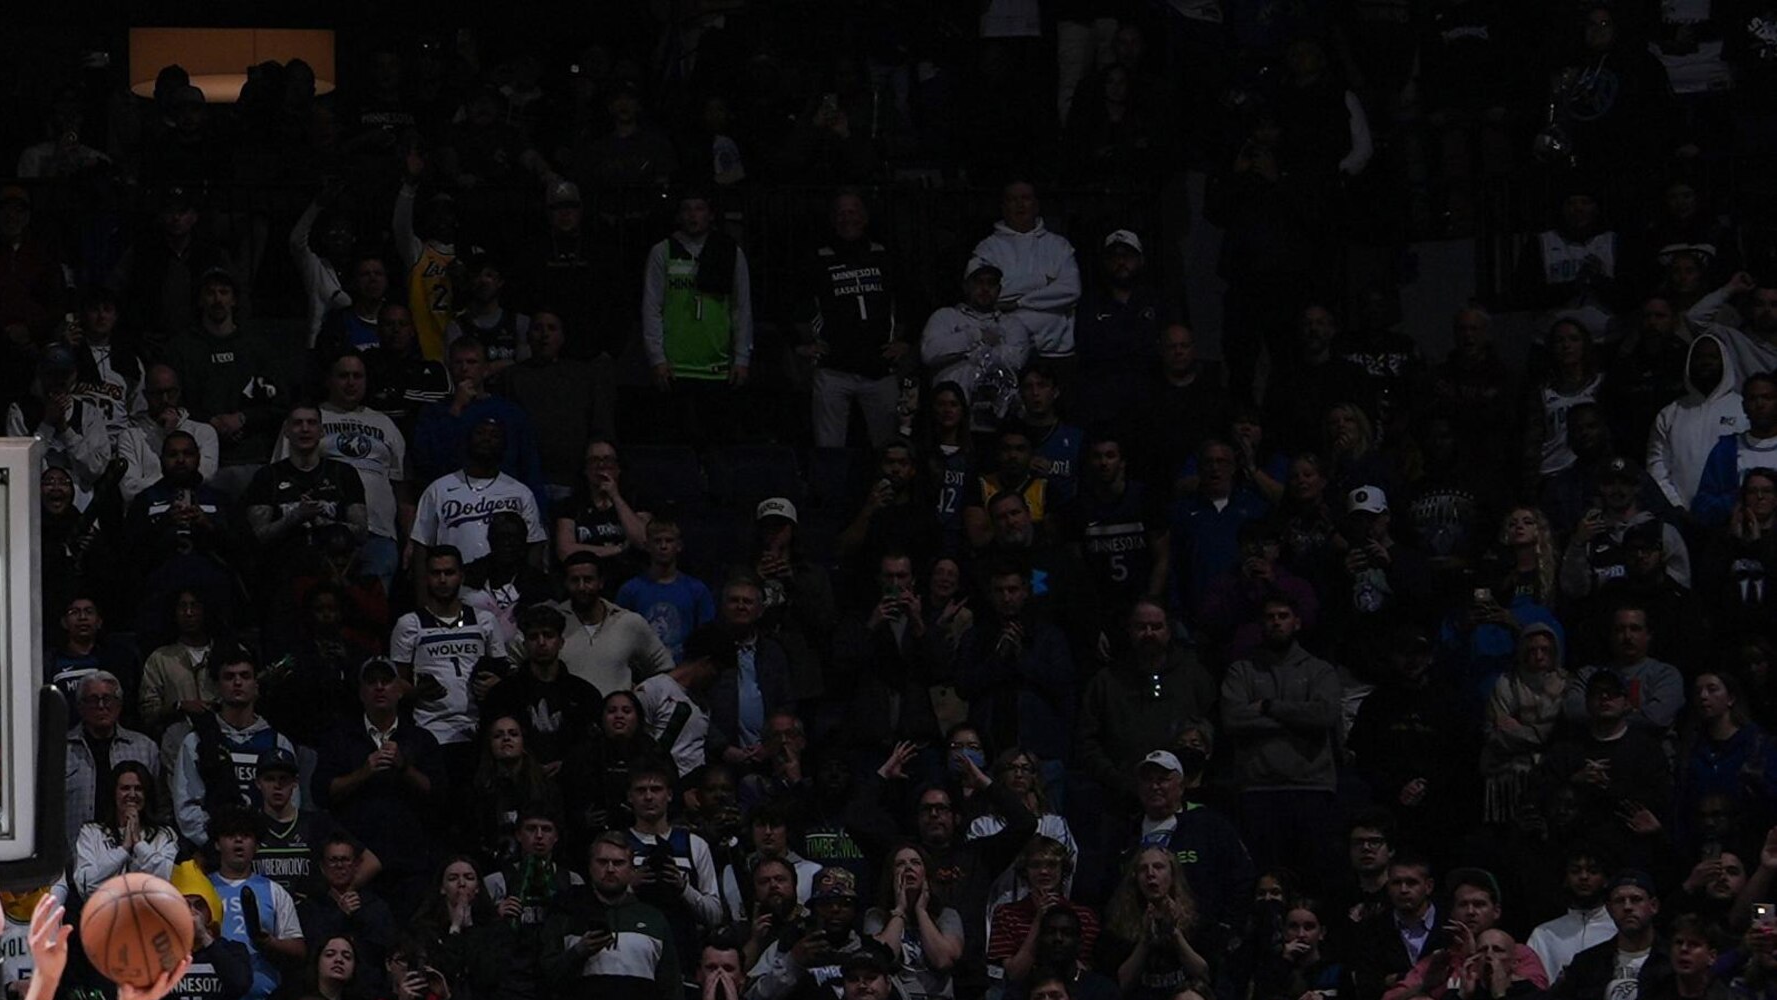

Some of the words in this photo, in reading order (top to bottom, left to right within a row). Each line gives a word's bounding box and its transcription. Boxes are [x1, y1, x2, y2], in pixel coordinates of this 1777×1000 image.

[831, 266, 882, 285] MINNESOTA
[833, 282, 885, 298] BASKETBALL
[856, 295, 868, 321] 1
[443, 497, 520, 527] Dodgers
[1110, 555, 1129, 582] 5
[427, 644, 478, 657] WOLVES
[450, 656, 462, 678] 1
